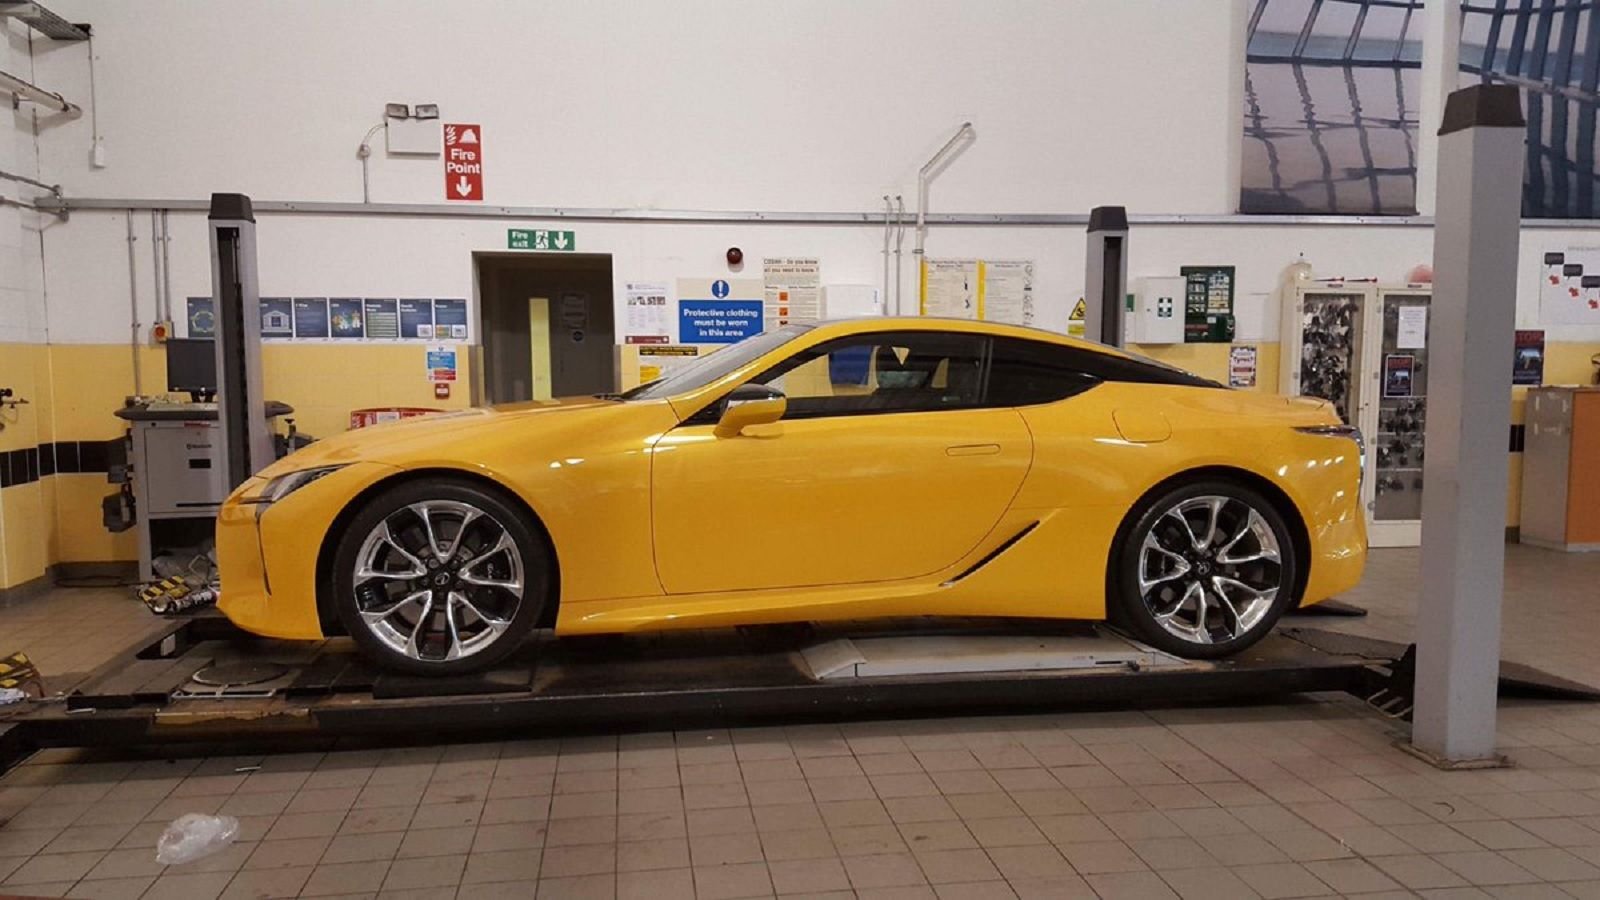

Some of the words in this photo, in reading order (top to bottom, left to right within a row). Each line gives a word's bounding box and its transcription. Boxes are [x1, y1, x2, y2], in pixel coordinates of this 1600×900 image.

[451, 148, 476, 160] Fire
[447, 162, 480, 174] Point
[512, 231, 528, 239] Fire
[512, 240, 529, 248] exit
[683, 308, 725, 317] Protective
[726, 308, 759, 318] clothing
[694, 319, 714, 327] must
[715, 319, 726, 327] be
[700, 328, 708, 337] in
[708, 328, 724, 337] this
[725, 329, 744, 337] area
